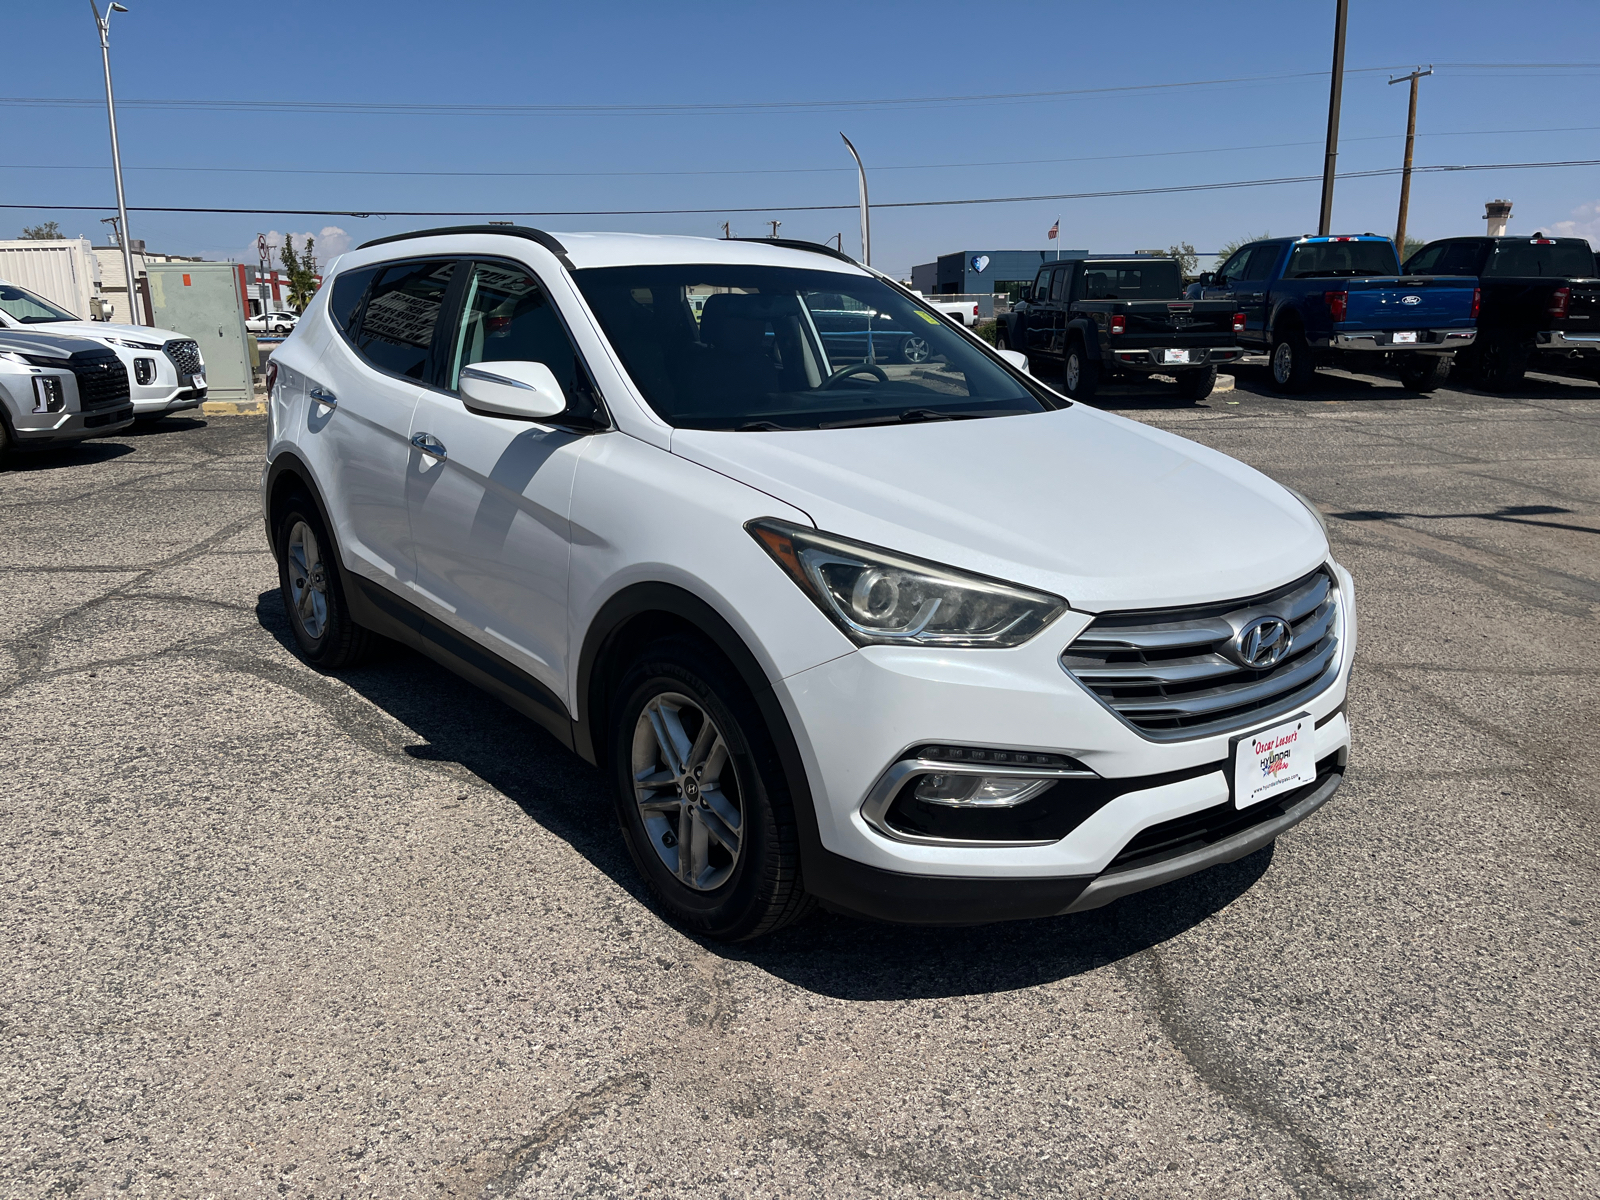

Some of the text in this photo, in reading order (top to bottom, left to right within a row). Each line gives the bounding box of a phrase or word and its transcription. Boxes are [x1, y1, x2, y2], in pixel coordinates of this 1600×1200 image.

[1403, 296, 1419, 304] Ford
[1255, 740, 1275, 755] Oscar
[1260, 749, 1291, 768] HYUNDAI
